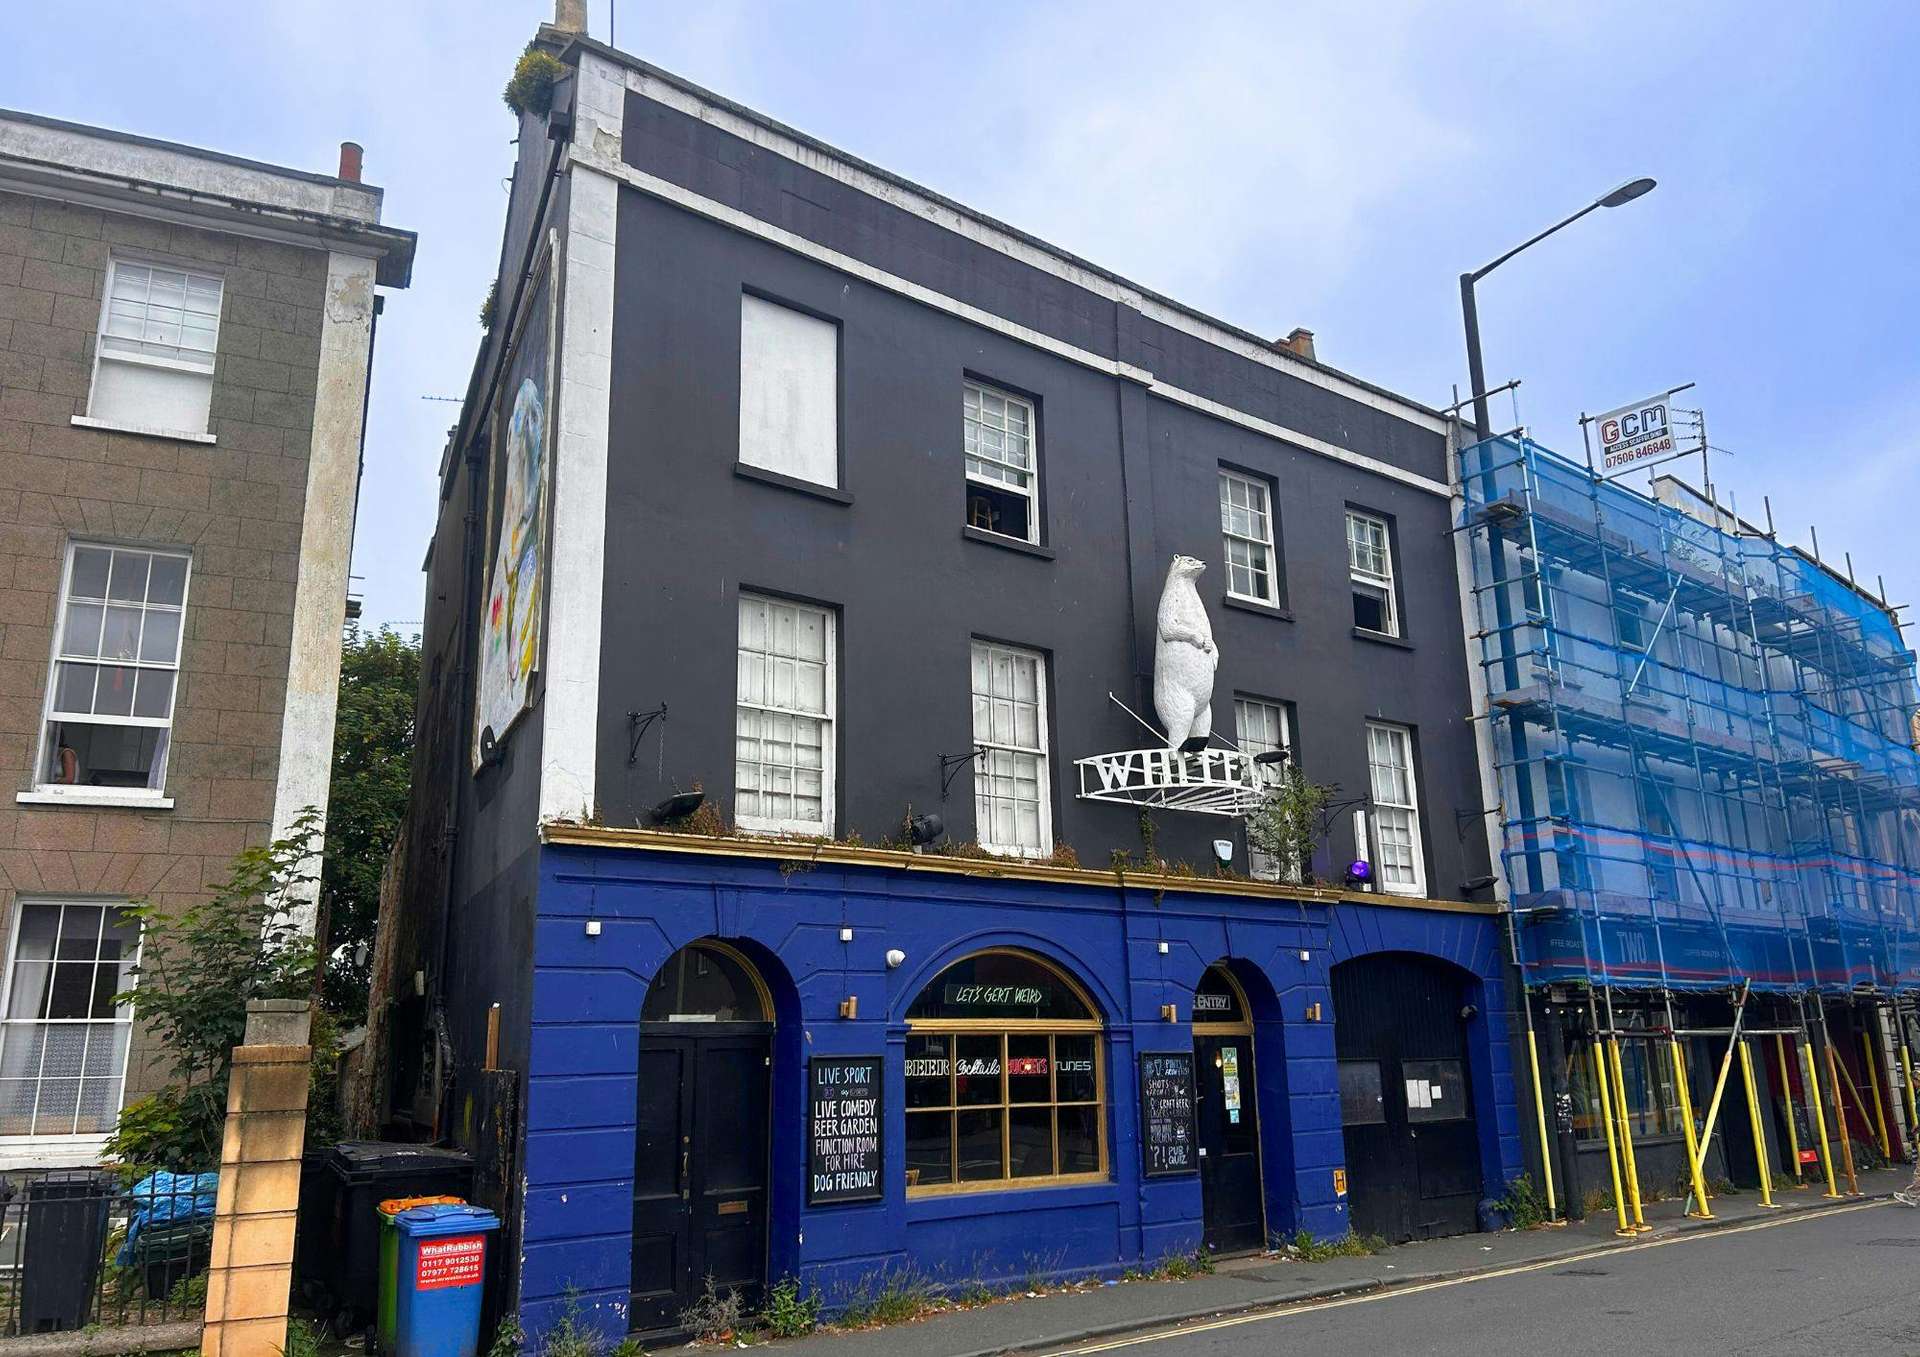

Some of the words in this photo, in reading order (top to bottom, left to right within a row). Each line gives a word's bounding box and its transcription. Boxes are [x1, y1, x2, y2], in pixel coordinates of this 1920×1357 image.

[1605, 452, 1634, 468] 07506
[1635, 438, 1671, 458] 846848
[1616, 931, 1649, 964] TWO
[956, 986, 983, 1003] LET'S
[984, 987, 1013, 1003] GERT
[1014, 988, 1042, 1004] WEIRD
[1197, 995, 1227, 1009] ENTRY
[818, 1067, 840, 1084] LIVE
[844, 1066, 872, 1084] SPORT
[904, 1059, 950, 1076] BEER
[955, 1059, 1001, 1075] Cocktails
[1055, 1060, 1091, 1071] TUNES
[1148, 1080, 1169, 1089] SHOTS
[815, 1101, 837, 1118] LIVE
[841, 1099, 876, 1117] COMEDY
[814, 1119, 839, 1137] BEER
[841, 1117, 877, 1135] GARDEN
[816, 1138, 854, 1156] FUNCTION
[856, 1137, 877, 1153] ROOM
[1168, 1145, 1184, 1156] PUB
[825, 1155, 841, 1172] FOR
[844, 1153, 865, 1170] HIRE
[1168, 1155, 1188, 1165] QUIZ
[814, 1174, 833, 1193] DOG
[835, 1170, 878, 1191] FRIENDLY
[422, 1241, 482, 1255] WhatRubbish
[422, 1259, 443, 1267] 0117
[421, 1268, 447, 1277] 07977
